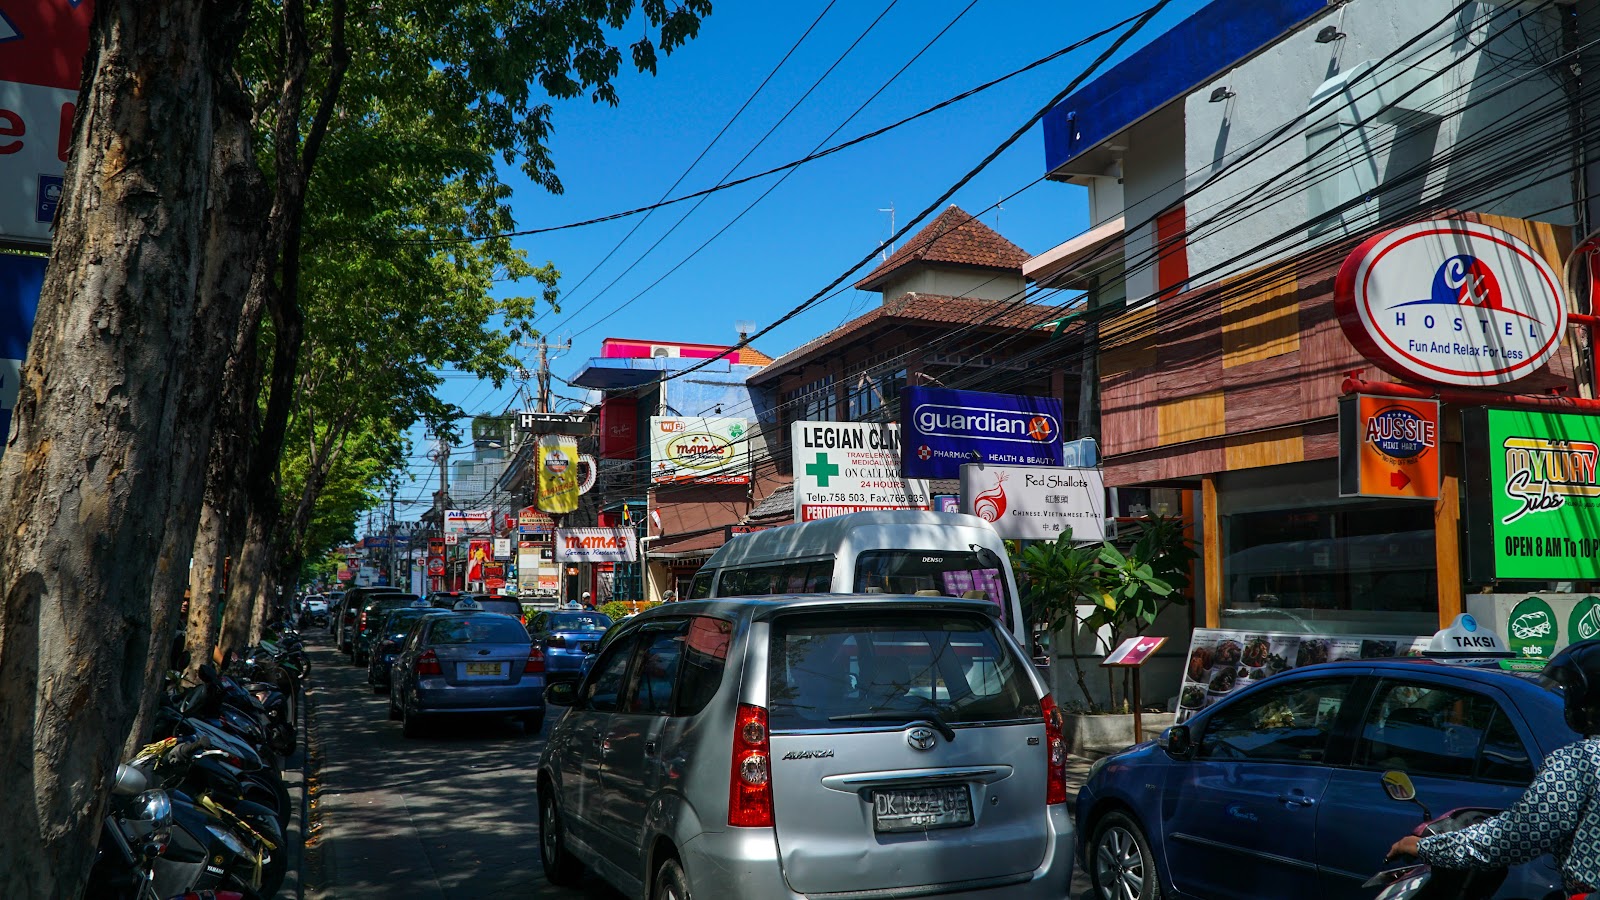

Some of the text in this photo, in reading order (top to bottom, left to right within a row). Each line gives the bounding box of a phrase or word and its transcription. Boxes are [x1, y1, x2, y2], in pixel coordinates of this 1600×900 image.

[1395, 312, 1537, 338] HOSTEL
[1409, 340, 1523, 359] Fun And Relax For Less
[919, 409, 1025, 436] guardian
[804, 427, 864, 449] LEGIAN
[1365, 416, 1435, 448] AUSSIE
[988, 453, 1017, 463] HEALTH
[1019, 455, 1025, 463] &
[1026, 455, 1056, 465] BEAUTY
[1505, 448, 1598, 484] MYWAY
[845, 468, 858, 478] ON
[860, 468, 883, 479] CALL
[873, 481, 906, 489] HOURS
[1025, 474, 1088, 489] Red Shallots
[806, 492, 924, 503] Telp.758 503, Fax.765 935
[1503, 470, 1564, 523] Subs
[565, 549, 590, 557] German
[1505, 536, 1600, 558] OPEN 8 AM To 10 P
[1452, 636, 1496, 648] TAKSI
[1522, 644, 1543, 655] subs
[781, 749, 835, 761] AVANZA
[876, 793, 897, 815] DK
[207, 865, 225, 875] YAMAHA
